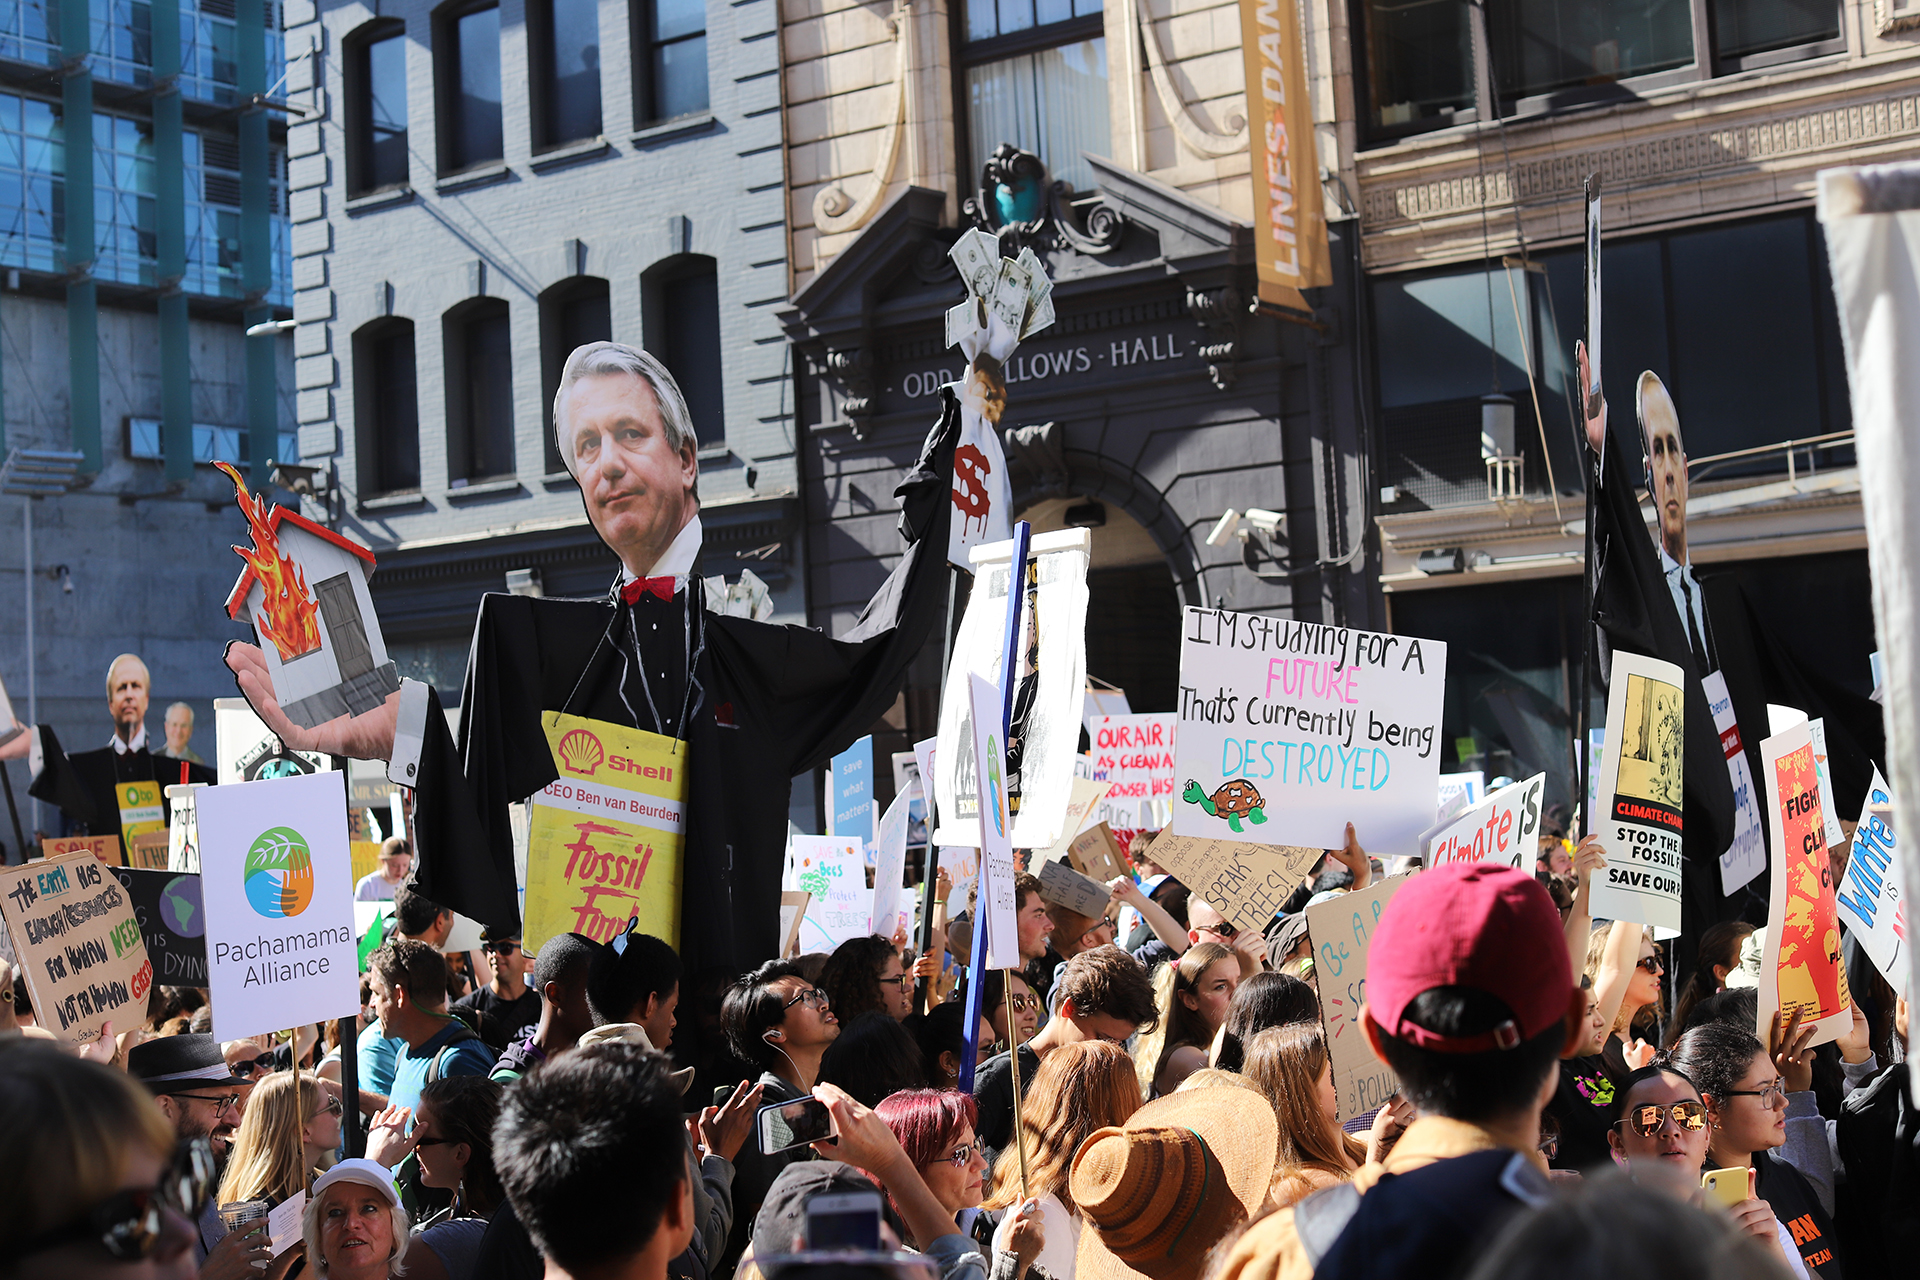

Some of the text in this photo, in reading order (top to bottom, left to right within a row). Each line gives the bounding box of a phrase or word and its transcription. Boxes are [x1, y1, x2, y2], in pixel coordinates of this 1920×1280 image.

[1265, 121, 1300, 276] LINES
[903, 333, 1183, 399] ODD LLOWS HALL
[1188, 608, 1238, 648] I'M
[1402, 639, 1425, 674] A
[1265, 657, 1362, 704] FUTURE
[1134, 723, 1163, 748] AIR
[1180, 685, 1239, 725] That's
[1368, 710, 1435, 759] being
[608, 754, 673, 782] Shell
[843, 759, 863, 775] save
[1093, 770, 1108, 781] MY
[1097, 755, 1116, 769] AS
[1120, 752, 1160, 770] CLEAN
[1222, 737, 1390, 791] DESTROYED
[140, 788, 153, 803] bp
[544, 783, 681, 823] CEO Ben van Beurden
[843, 780, 864, 798] what
[1104, 781, 1148, 798] ROWSER
[1786, 785, 1821, 820] FIGHT
[837, 800, 870, 823] matters
[1616, 802, 1664, 824] CLIMATE
[813, 845, 834, 859] SAVE
[1149, 839, 1179, 861] They
[1617, 827, 1657, 846] STOP
[1660, 835, 1678, 852] THE
[564, 820, 654, 891] Fossil
[1631, 846, 1675, 867] FOSSIL
[8, 878, 38, 913] THE
[37, 865, 70, 895] EARTH
[76, 863, 102, 890] HAS
[1205, 858, 1252, 912] SPEAK
[1230, 877, 1259, 911] FOR THE
[1609, 868, 1651, 889] SAVE
[1653, 876, 1676, 893] OUR
[1232, 869, 1294, 929] TREES!
[24, 910, 67, 946] ENOUGH
[61, 884, 123, 931] RESOURCES
[825, 911, 868, 928] TREES
[44, 917, 140, 984] FOR HUMAN NEED
[154, 933, 167, 947] IS
[215, 926, 350, 965] Pachamama
[1321, 941, 1350, 977] Be
[1352, 912, 1367, 947] A
[243, 957, 330, 988] Alliance
[54, 993, 79, 1031] NOT
[88, 979, 130, 1013] HUMAN
[131, 959, 154, 1000] GREED
[1804, 1247, 1834, 1268] TEAM
